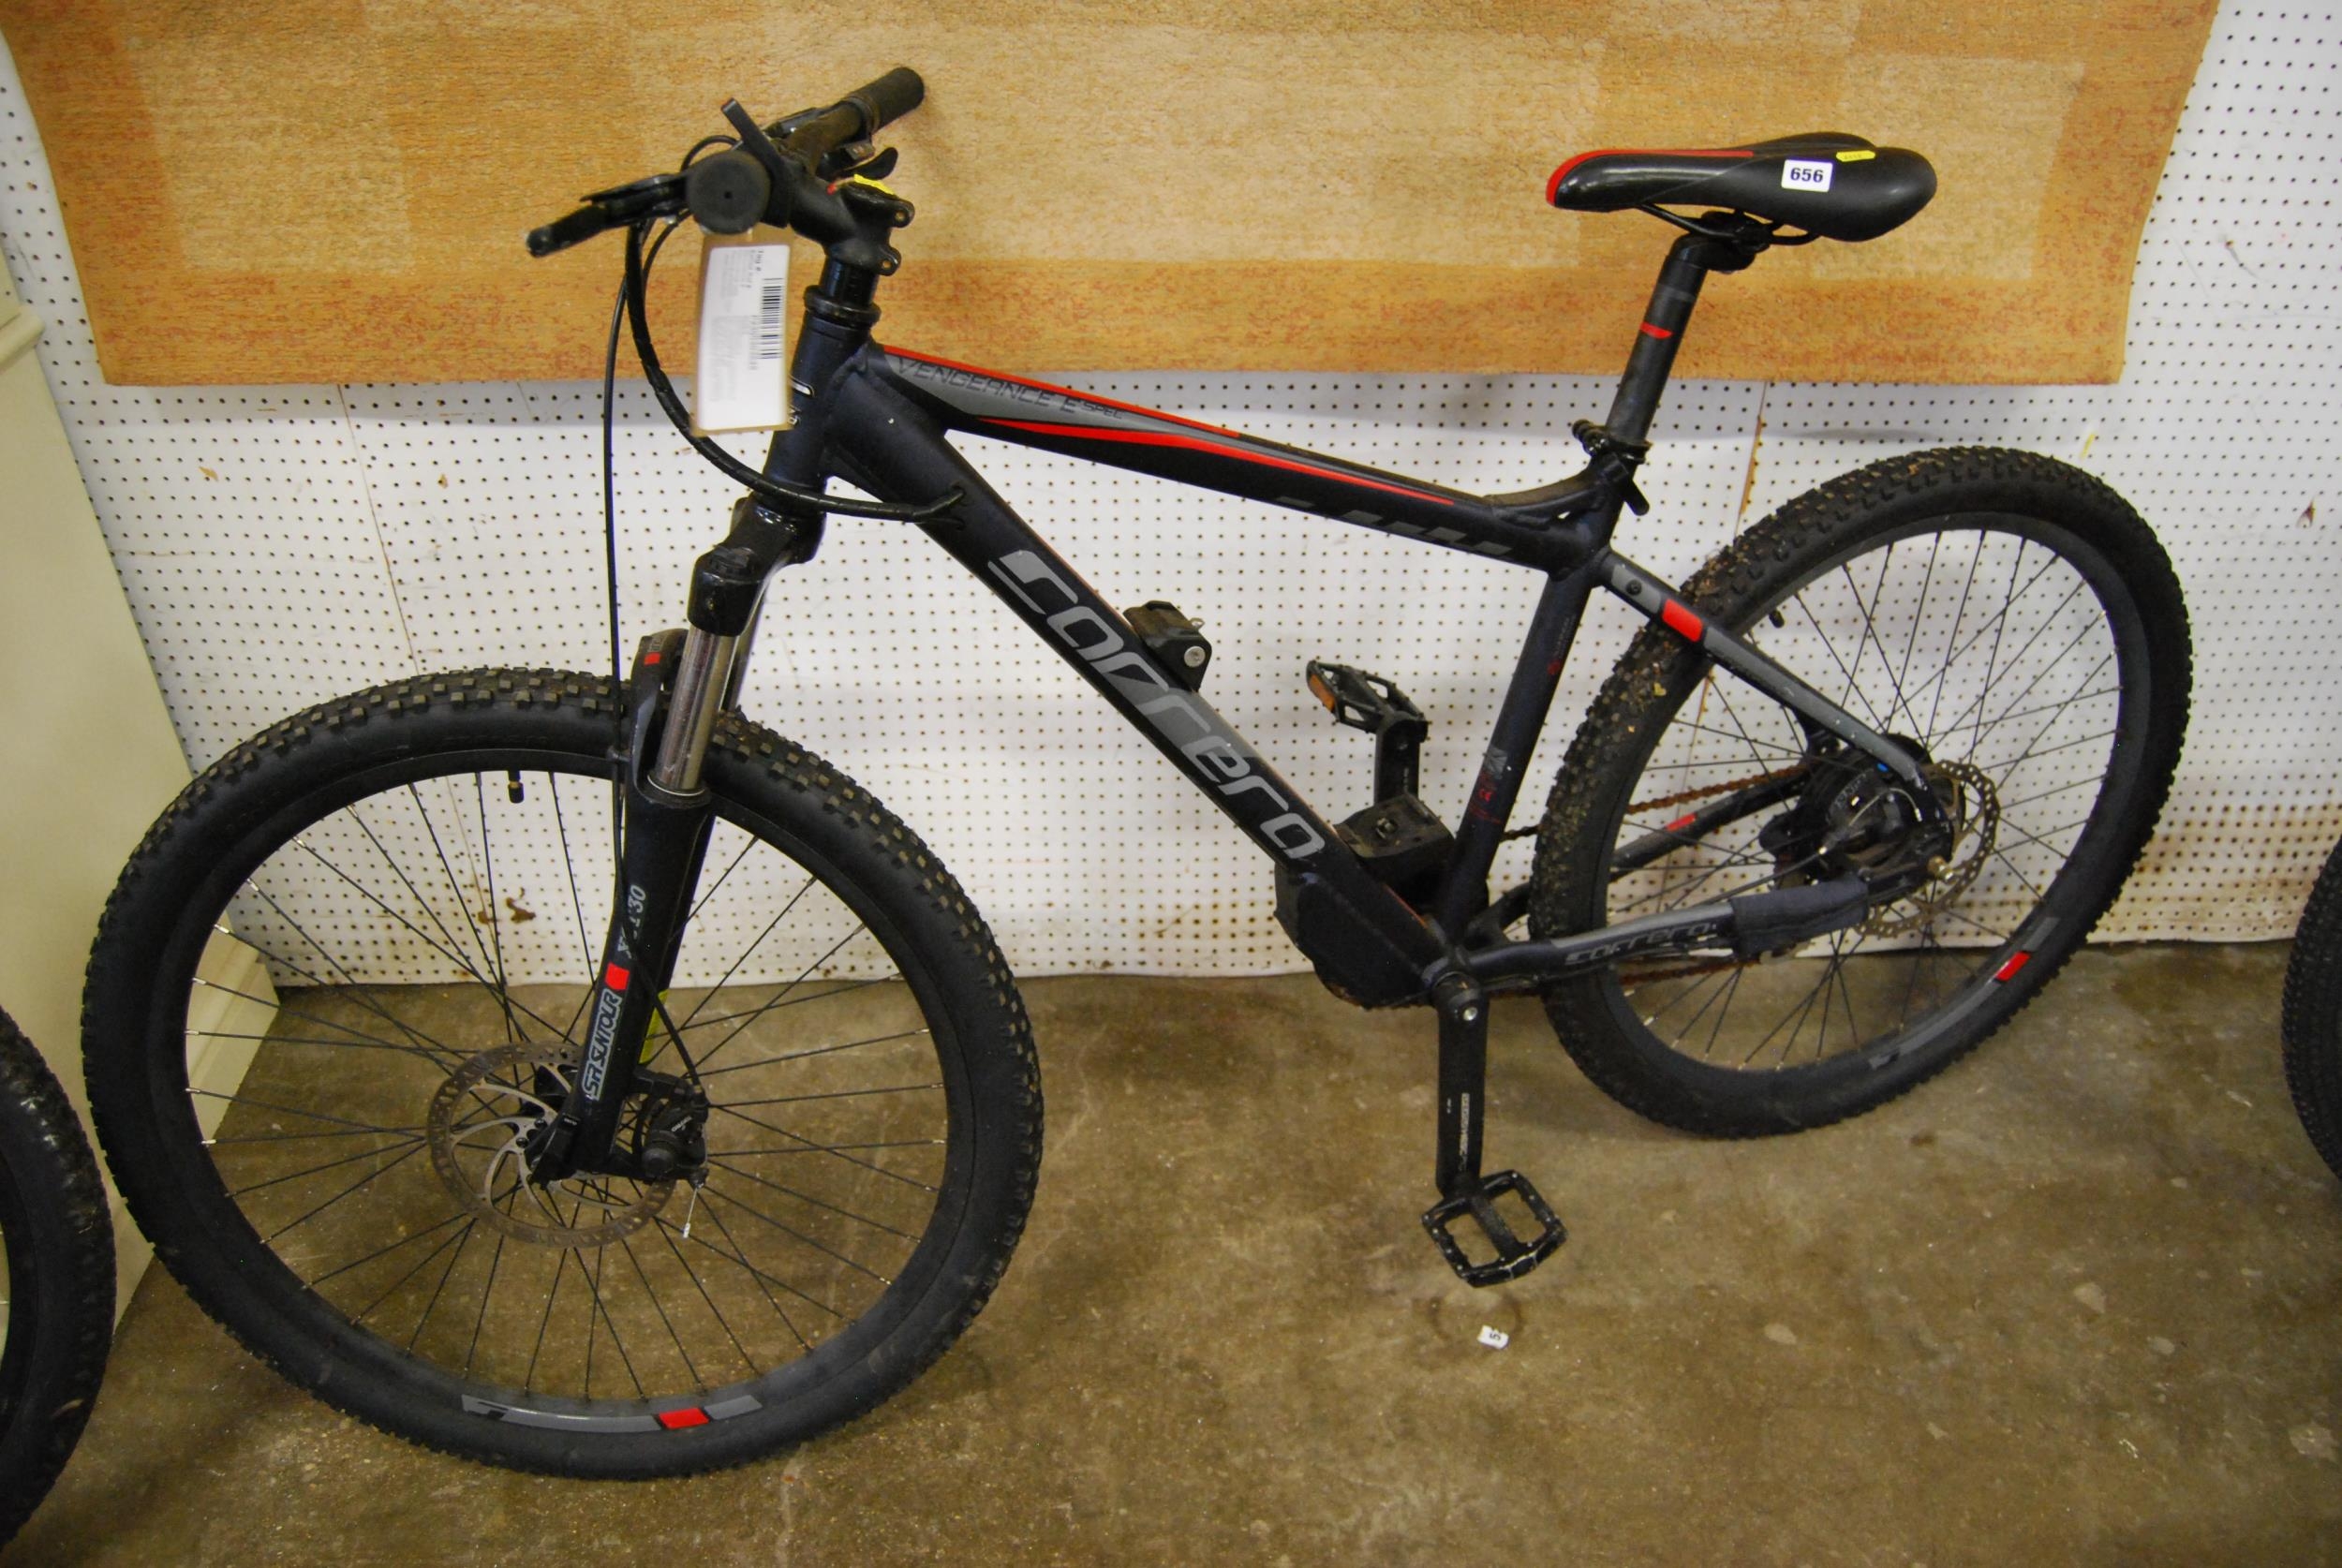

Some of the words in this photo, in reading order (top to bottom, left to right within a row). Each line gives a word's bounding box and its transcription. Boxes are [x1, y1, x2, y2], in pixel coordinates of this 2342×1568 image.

[1789, 167, 1824, 184] 656
[897, 357, 1057, 407] VENGEANCE
[590, 991, 620, 1067] SUNTOUR
[584, 1065, 602, 1097] SR
